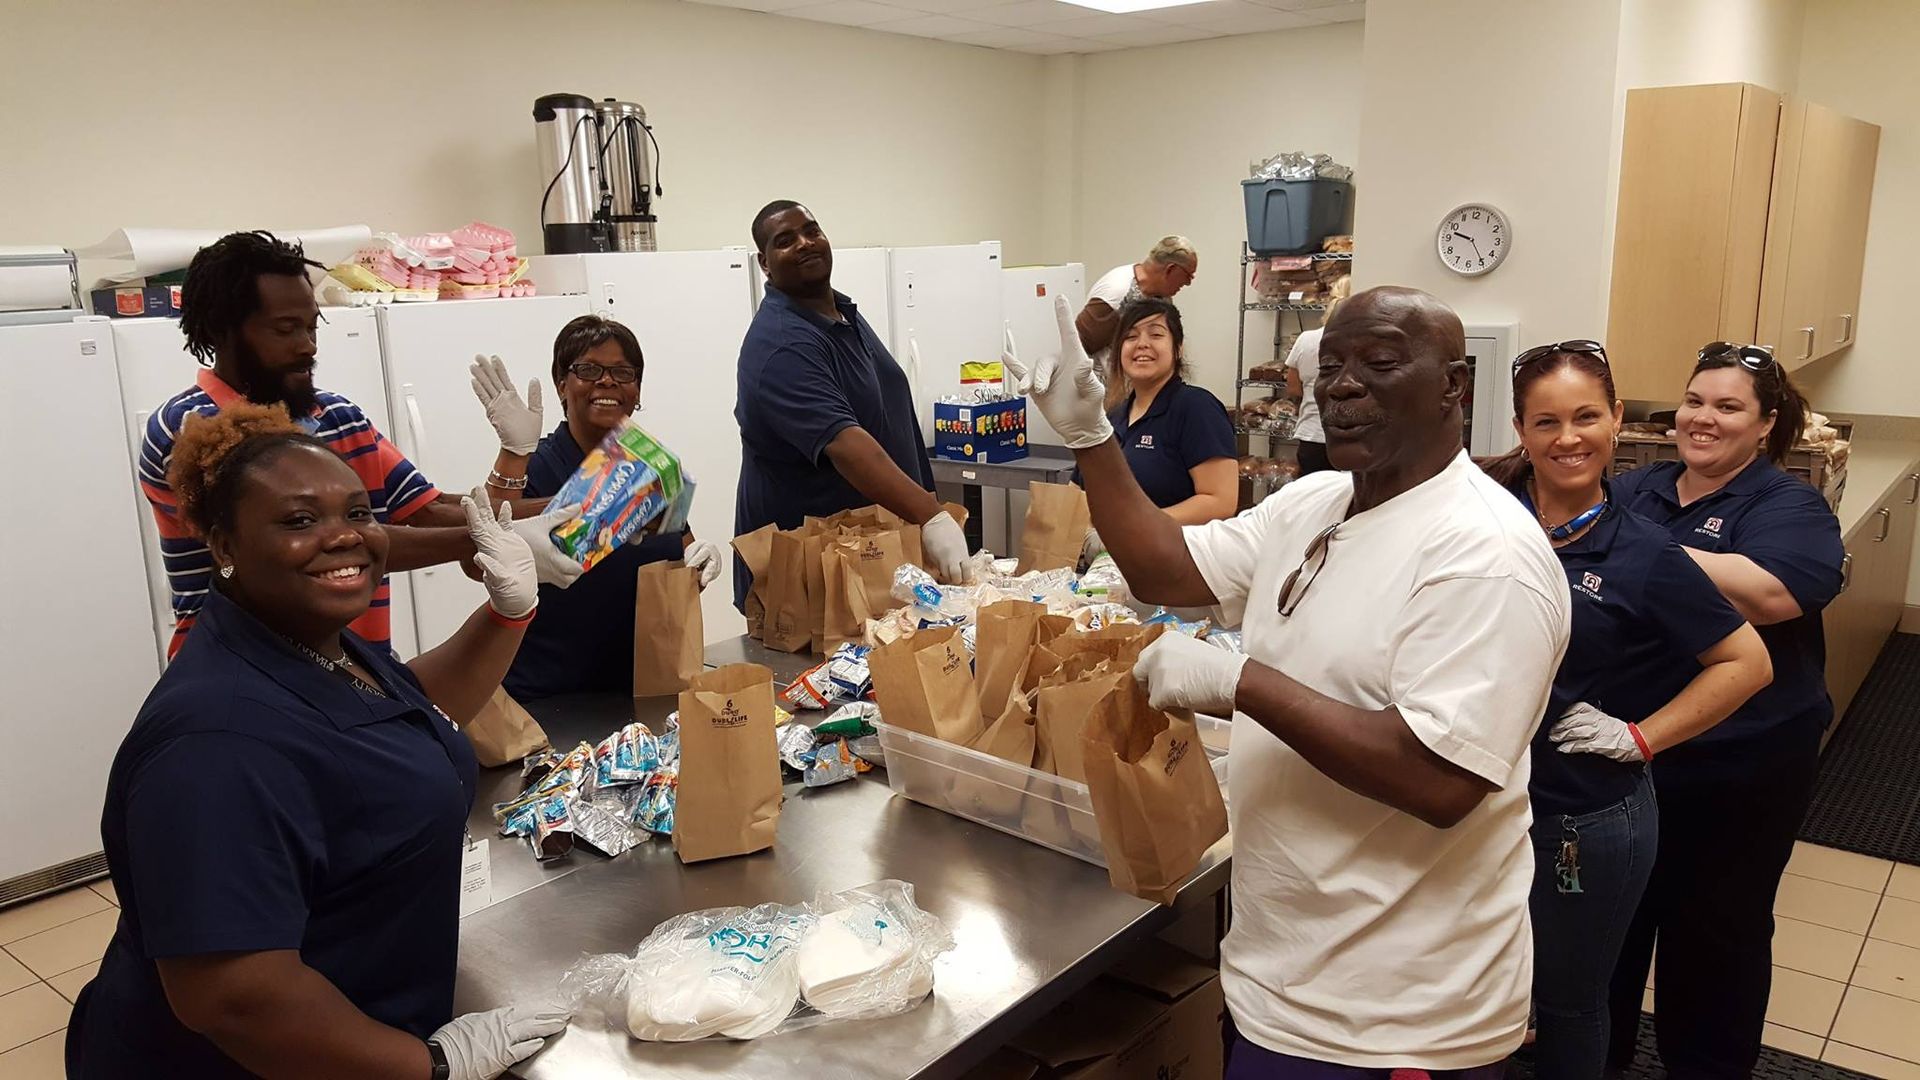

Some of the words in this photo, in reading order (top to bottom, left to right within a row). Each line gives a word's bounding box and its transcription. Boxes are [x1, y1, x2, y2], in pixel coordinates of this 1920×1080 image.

[1461, 214, 1467, 222] 11
[1472, 211, 1481, 220] 12
[1450, 222, 1459, 231] 10
[1492, 225, 1499, 233] 2
[1445, 234, 1452, 242] 9
[1494, 238, 1501, 246] 3
[1447, 246, 1453, 254] 8
[1489, 250, 1495, 258] 4
[1455, 256, 1461, 264] 7
[1465, 260, 1472, 268] 6
[1478, 258, 1485, 266] 5
[1572, 584, 1604, 601] RESTORE
[727, 699, 733, 708] 6
